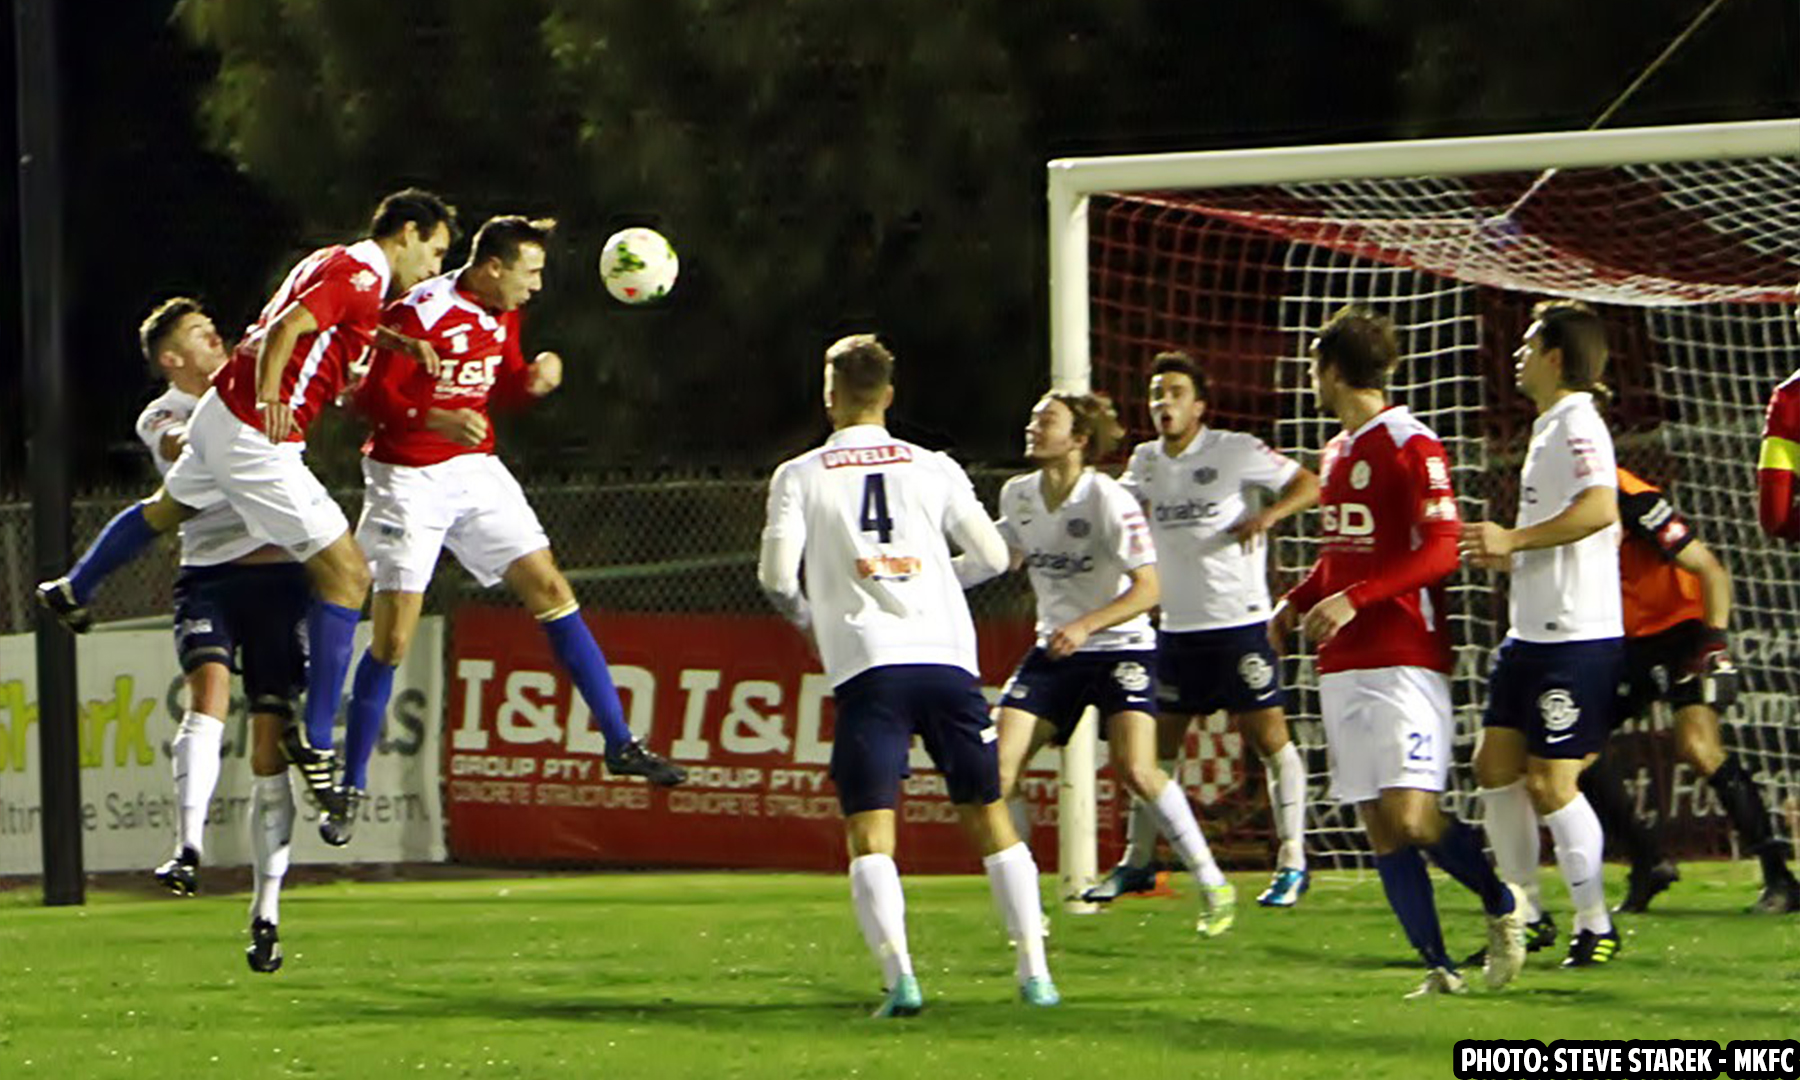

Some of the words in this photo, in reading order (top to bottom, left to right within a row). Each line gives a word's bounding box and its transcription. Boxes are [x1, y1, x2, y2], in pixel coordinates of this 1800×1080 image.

[824, 448, 912, 467] DIVELLA
[861, 473, 893, 543] 4
[452, 755, 535, 777] GROUP
[543, 759, 593, 779] PTY
[771, 770, 827, 791] PTY
